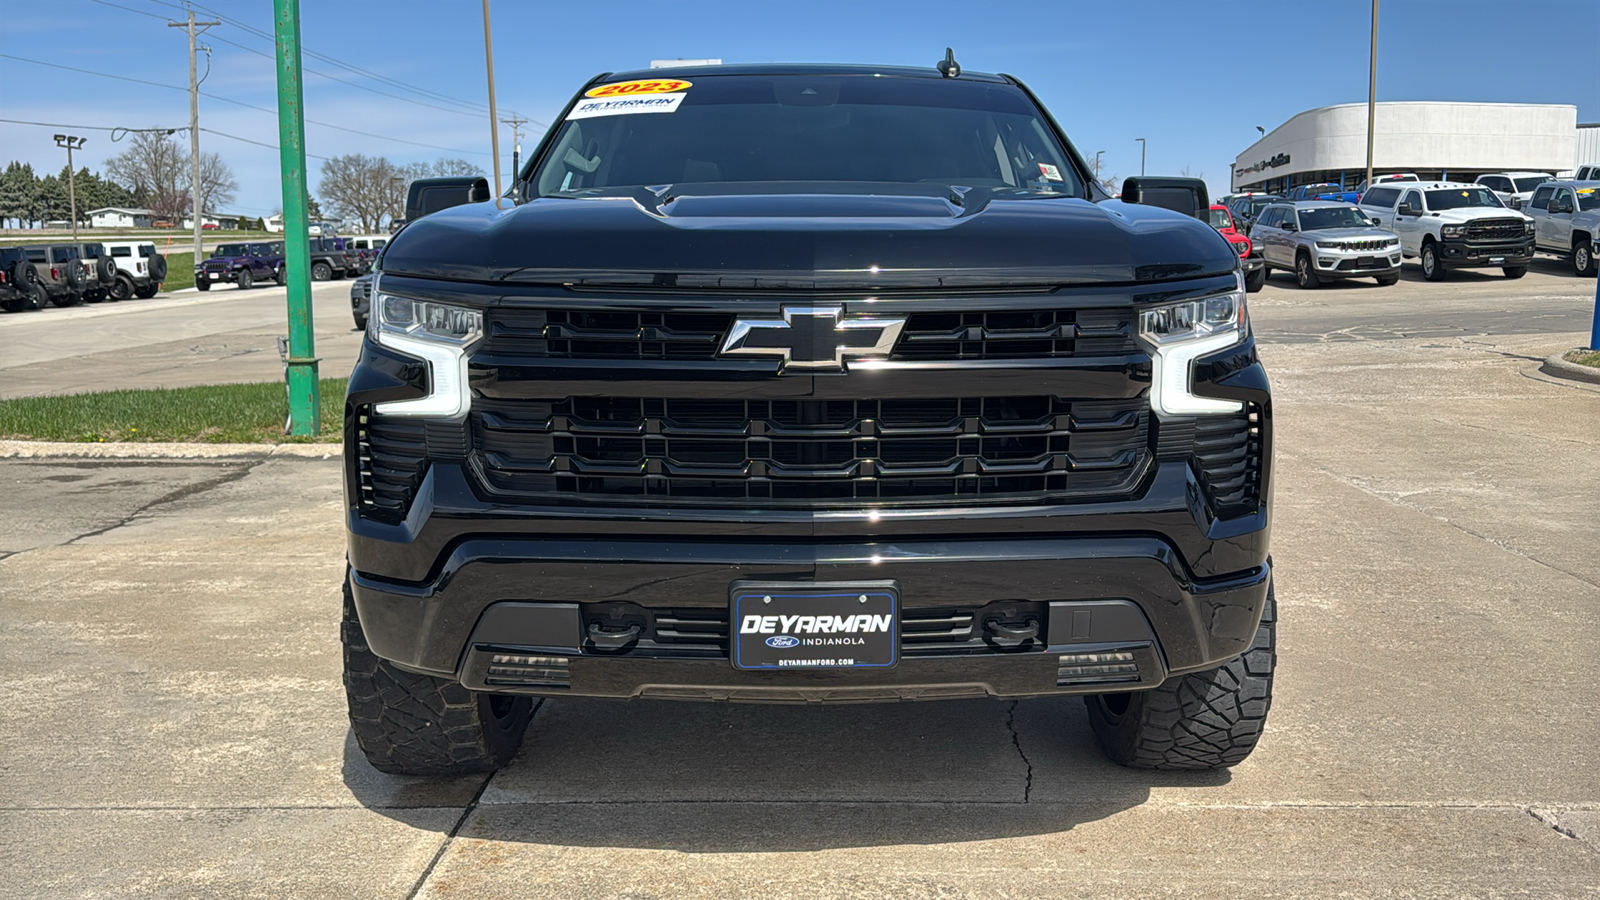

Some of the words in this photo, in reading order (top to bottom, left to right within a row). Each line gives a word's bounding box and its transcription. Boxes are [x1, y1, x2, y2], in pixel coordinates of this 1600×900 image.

[595, 82, 683, 96] 2023
[579, 98, 676, 110] DEYARMAN
[739, 614, 892, 634] DEYARMAN
[771, 636, 793, 647] Ford
[802, 637, 865, 646] INDIANOLA
[778, 658, 854, 666] DEYARMANFORD.COM
